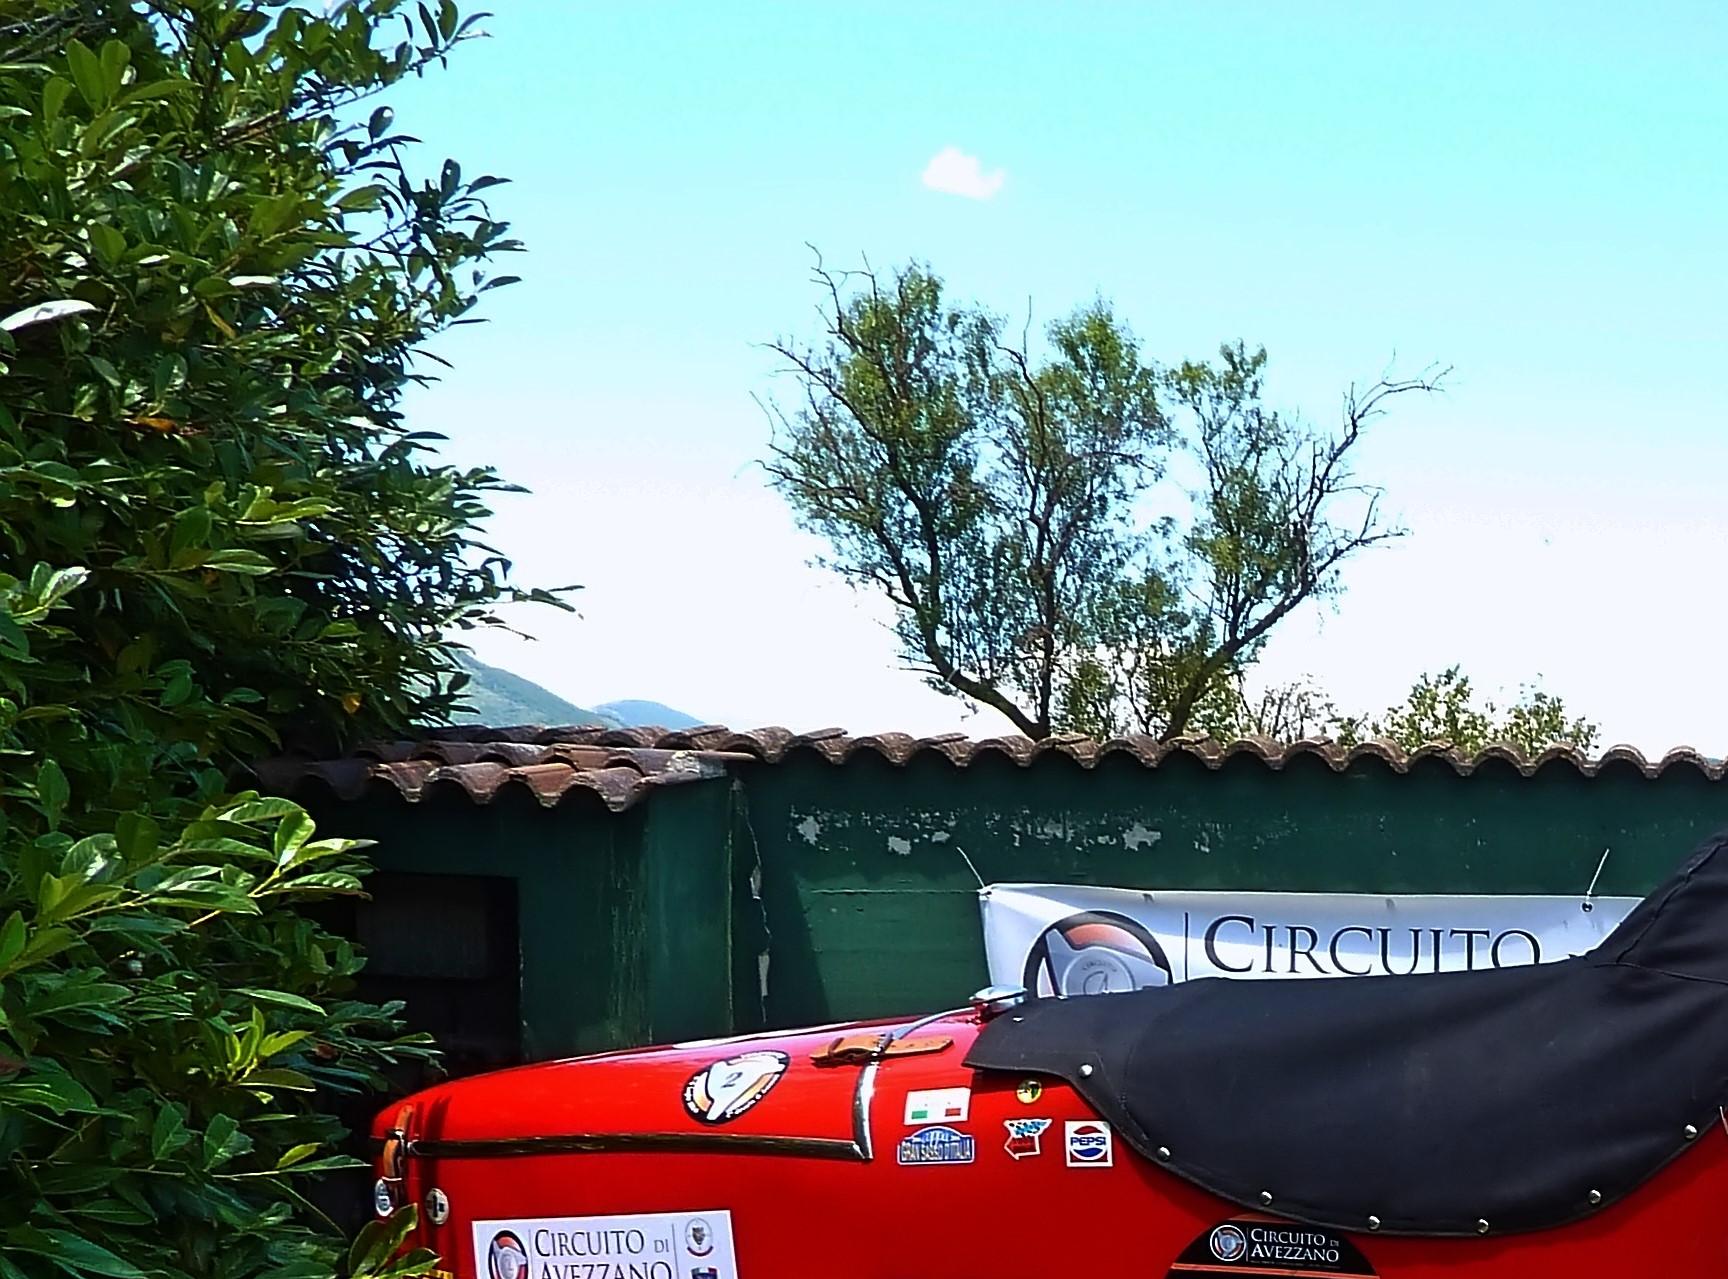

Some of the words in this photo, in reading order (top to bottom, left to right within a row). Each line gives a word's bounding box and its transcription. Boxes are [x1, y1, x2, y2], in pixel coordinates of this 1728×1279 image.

[1204, 915, 1541, 975] CIRCUITO
[720, 1071, 744, 1089] 2
[1070, 1136, 1107, 1147] PEPSI
[534, 1229, 645, 1257] CIRCUITO
[654, 1239, 669, 1254] DI
[1250, 1228, 1326, 1246] CIRCUITO
[1250, 1243, 1340, 1263] AVEZZANO
